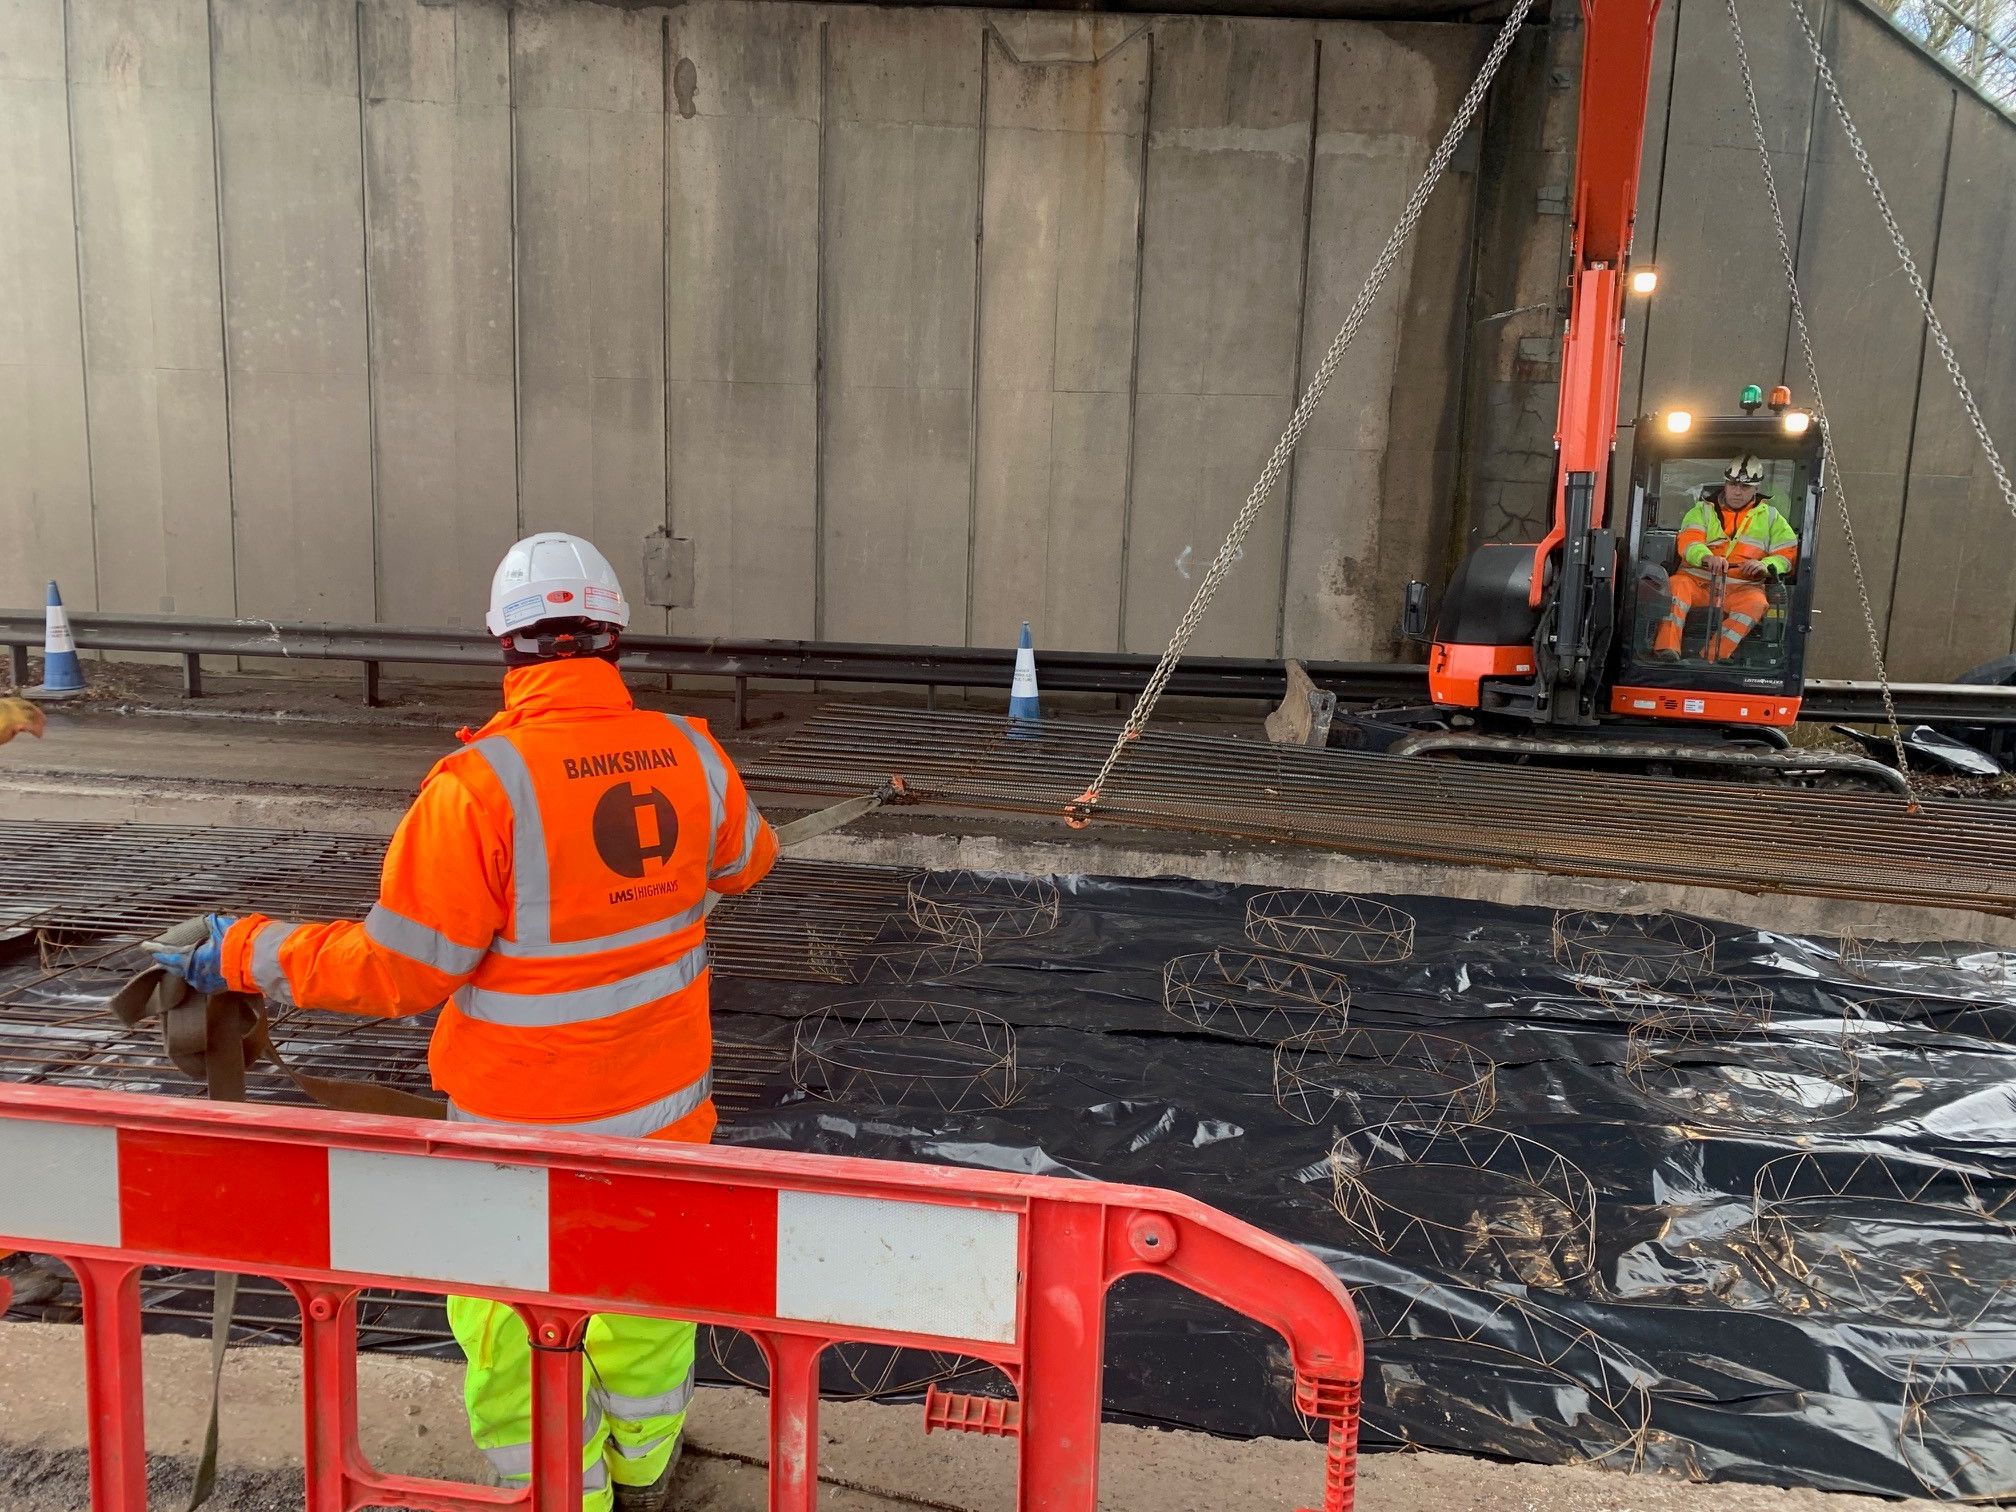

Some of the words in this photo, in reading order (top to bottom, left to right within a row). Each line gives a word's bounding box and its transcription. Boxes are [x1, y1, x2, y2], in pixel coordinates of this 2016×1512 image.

[563, 748, 678, 780] BANKSMAN
[609, 888, 634, 905] LMS
[637, 880, 679, 900] HIGHWAYS
